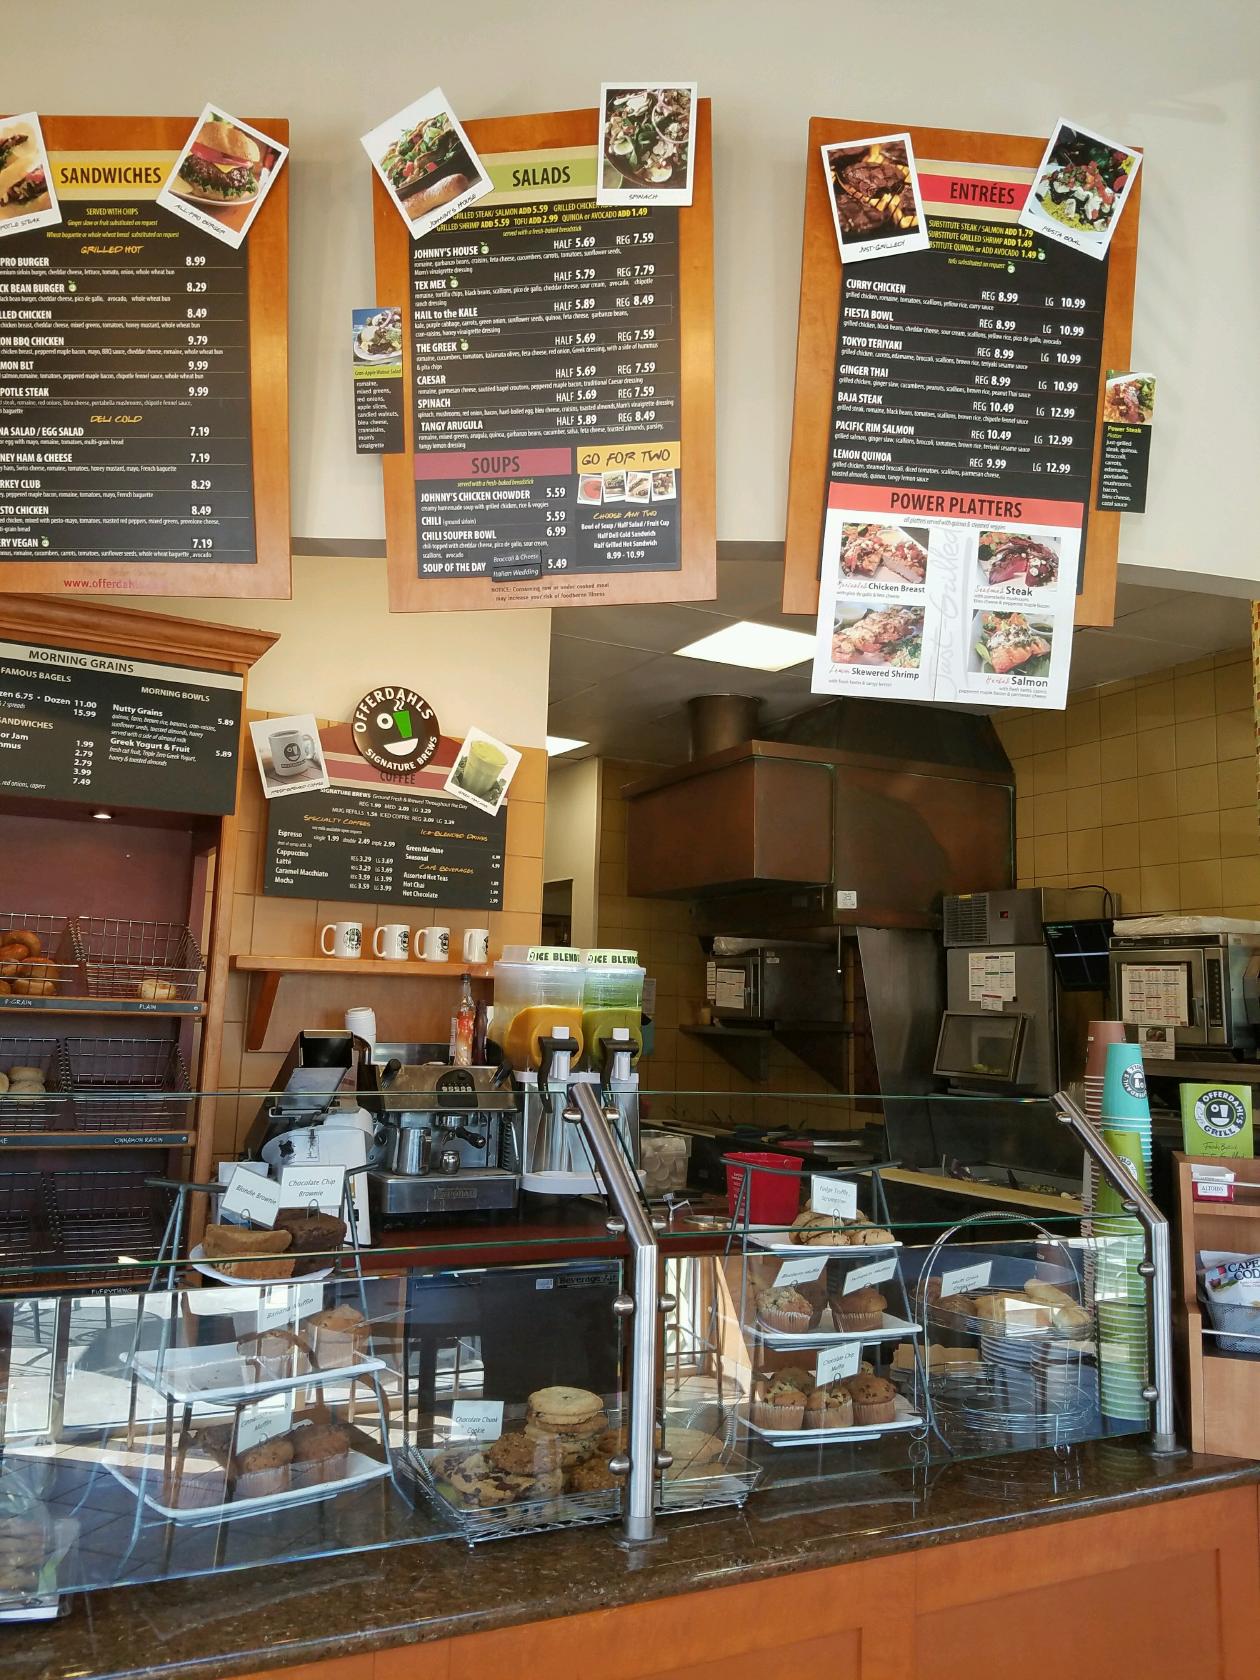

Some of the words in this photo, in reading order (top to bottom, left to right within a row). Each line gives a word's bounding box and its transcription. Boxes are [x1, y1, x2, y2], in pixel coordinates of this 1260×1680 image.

[60, 167, 162, 184] SANDWICHES
[512, 166, 570, 187] SALADS
[950, 182, 1015, 204] ENTRÉES
[81, 246, 123, 254] GRILLED
[125, 246, 143, 254] HOT
[414, 247, 451, 259] JOHNNY'S
[452, 245, 478, 257] HOUSE
[554, 239, 572, 250] HALF
[575, 236, 595, 248] 5.69
[617, 235, 631, 245] REG
[634, 232, 654, 244] 7.59
[18, 257, 49, 267] BURGER
[186, 257, 205, 266] 8.99
[415, 280, 428, 291] TEX
[429, 280, 446, 290] MEX
[554, 271, 572, 282] HALF
[575, 269, 595, 281] 5.79
[617, 267, 631, 277] REG
[634, 265, 654, 276] 7.79
[11, 284, 31, 293] BEAN
[33, 284, 64, 293] BURGER
[187, 282, 206, 293] 8.29
[846, 279, 871, 290] CURRY
[873, 281, 906, 293] CHICKEN
[981, 290, 995, 301] REG
[999, 292, 1018, 303] 8.99
[1045, 296, 1053, 306] LG
[1061, 297, 1085, 309] 10.99
[18, 310, 51, 320] CHICKEN
[187, 309, 207, 318] 8.49
[415, 309, 431, 321] HAIL
[434, 309, 442, 320] to
[444, 309, 457, 318] the
[459, 307, 478, 318] KALE
[844, 307, 869, 319] FIESTA
[871, 310, 893, 321] BOWL
[14, 337, 30, 346] BBQ
[32, 337, 64, 346] CHICKEN
[188, 336, 208, 346] 9.79
[842, 336, 867, 347] TOKYO
[869, 338, 902, 350] TERIYAKI
[416, 343, 430, 352] THE
[432, 342, 457, 352] GREEK
[20, 361, 34, 370] BLT
[188, 361, 208, 370] 9.99
[840, 364, 868, 377] GINGER
[870, 367, 889, 378] THAI
[25, 388, 49, 397] STEAK
[189, 386, 208, 397] 9.99
[838, 392, 856, 404] BAJA
[859, 394, 883, 405] STEAK
[973, 401, 987, 411] REG
[989, 401, 1014, 413] 10.49
[1036, 407, 1044, 417] LG
[1051, 407, 1075, 418] 12.99
[421, 422, 445, 432] TANGY
[447, 420, 482, 430] ARUGULA
[836, 421, 863, 432] PACIFIC
[865, 423, 880, 433] RIM
[882, 423, 914, 436] SALMON
[11, 427, 35, 436] SALAD
[36, 427, 40, 436] /
[42, 427, 57, 436] EGG
[59, 427, 83, 437] SALAD
[190, 427, 210, 437] 7.19
[17, 453, 35, 463] HAM
[36, 454, 43, 463] &
[44, 454, 72, 463] CHEESE
[191, 453, 210, 463] 7.19
[582, 453, 600, 466] GO
[606, 451, 635, 466] FOR
[641, 449, 670, 462] TWO
[833, 449, 859, 461] LEMON
[862, 451, 891, 464] QUINOA
[472, 456, 520, 474] SOUPS
[21, 480, 40, 489] CLUB
[191, 480, 211, 490] 8.29
[421, 492, 457, 502] JOHNNY'S
[459, 491, 490, 501] CHICKEN
[492, 490, 530, 500] CHOWDER
[546, 488, 565, 498] 5.59
[891, 492, 944, 512] POWER
[950, 495, 1022, 518] PLATTERS
[16, 506, 48, 515] CHICKEN
[192, 506, 211, 516] 8.49
[422, 531, 442, 541] CHILI
[443, 530, 472, 540] SOUPER
[474, 530, 496, 539] BOWL
[546, 526, 566, 537] 6.99
[13, 539, 38, 548] VEGAN
[193, 539, 212, 549] 7.19
[423, 562, 442, 572] SOUP
[444, 562, 454, 572] OF
[455, 562, 468, 572] THE
[470, 562, 486, 572] DAY
[548, 559, 567, 569] 5.49
[868, 583, 899, 592] Chicken
[901, 584, 925, 593] Breast
[1006, 586, 1033, 596] Steak
[29, 650, 87, 667] MORNING
[90, 659, 134, 673] GRAINS
[1, 667, 37, 678] FAMOUS
[39, 672, 71, 683] BAGELS
[852, 667, 889, 678] Skewered
[892, 669, 919, 680] Shrimp
[1011, 677, 1048, 687] Salmon
[141, 687, 180, 698] MORNING
[182, 692, 210, 701] BOWLS
[15, 692, 33, 700] 6.75
[45, 696, 70, 705] Dozen
[75, 700, 97, 709] 11.00
[73, 709, 96, 717] 15.99
[113, 704, 136, 714] Nutty
[138, 708, 163, 717] Grains
[355, 688, 433, 732] OFFERDAHLS
[218, 718, 234, 726] 5.89
[11, 733, 29, 741] Jam
[111, 739, 134, 748] Greek
[136, 741, 162, 751] Yogurt
[172, 745, 190, 753] Fruit
[366, 749, 416, 771] SIGNATURE
[417, 736, 437, 766] BREWS
[74, 759, 92, 767] 2.79
[73, 768, 91, 776] 3.99
[278, 830, 302, 839] Espresso
[277, 849, 308, 857] Cappuccino
[422, 847, 443, 855] Machine
[276, 868, 299, 876] Caramel
[300, 869, 328, 878] Macchiato
[536, 952, 549, 961] ICE
[594, 956, 608, 964] ICE
[1202, 1091, 1244, 1127] OFFERDAHL'S
[1204, 1125, 1236, 1136] GRILL
[322, 1178, 336, 1186] Chip
[1228, 1261, 1260, 1272] CAPE
[1234, 1270, 1260, 1280] COD
